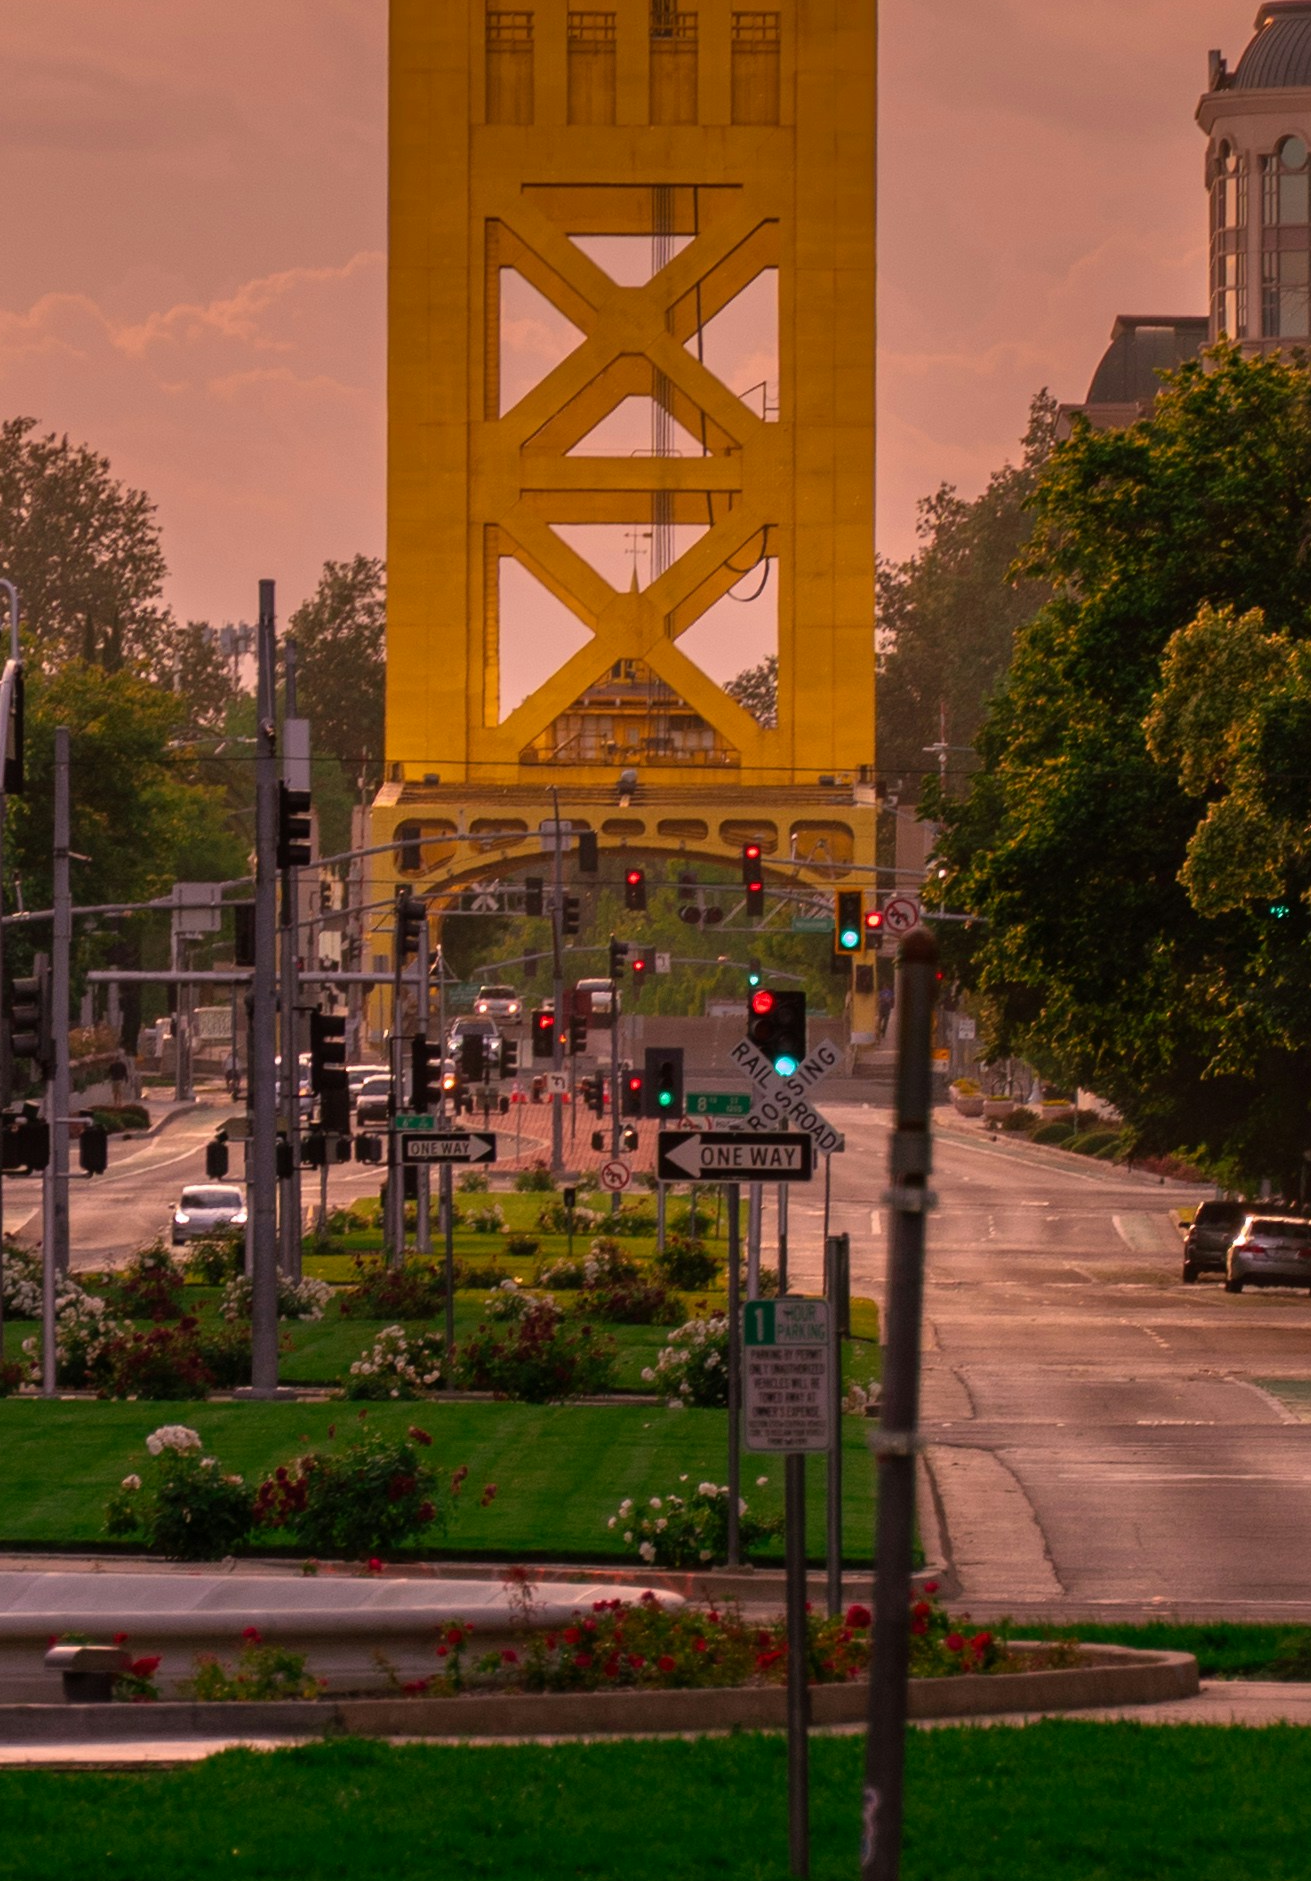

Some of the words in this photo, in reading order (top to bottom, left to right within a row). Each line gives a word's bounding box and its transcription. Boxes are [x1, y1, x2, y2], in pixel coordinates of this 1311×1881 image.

[731, 1042, 773, 1090] RAIL
[790, 1102, 837, 1151] ROAD
[747, 1046, 836, 1131] ROSSING
[410, 1142, 438, 1155] ONE
[441, 1142, 469, 1155] WAY
[701, 1147, 743, 1166] ONE
[750, 1147, 795, 1166] WAY
[754, 1307, 764, 1342] 1
[776, 1323, 826, 1340] PARKING
